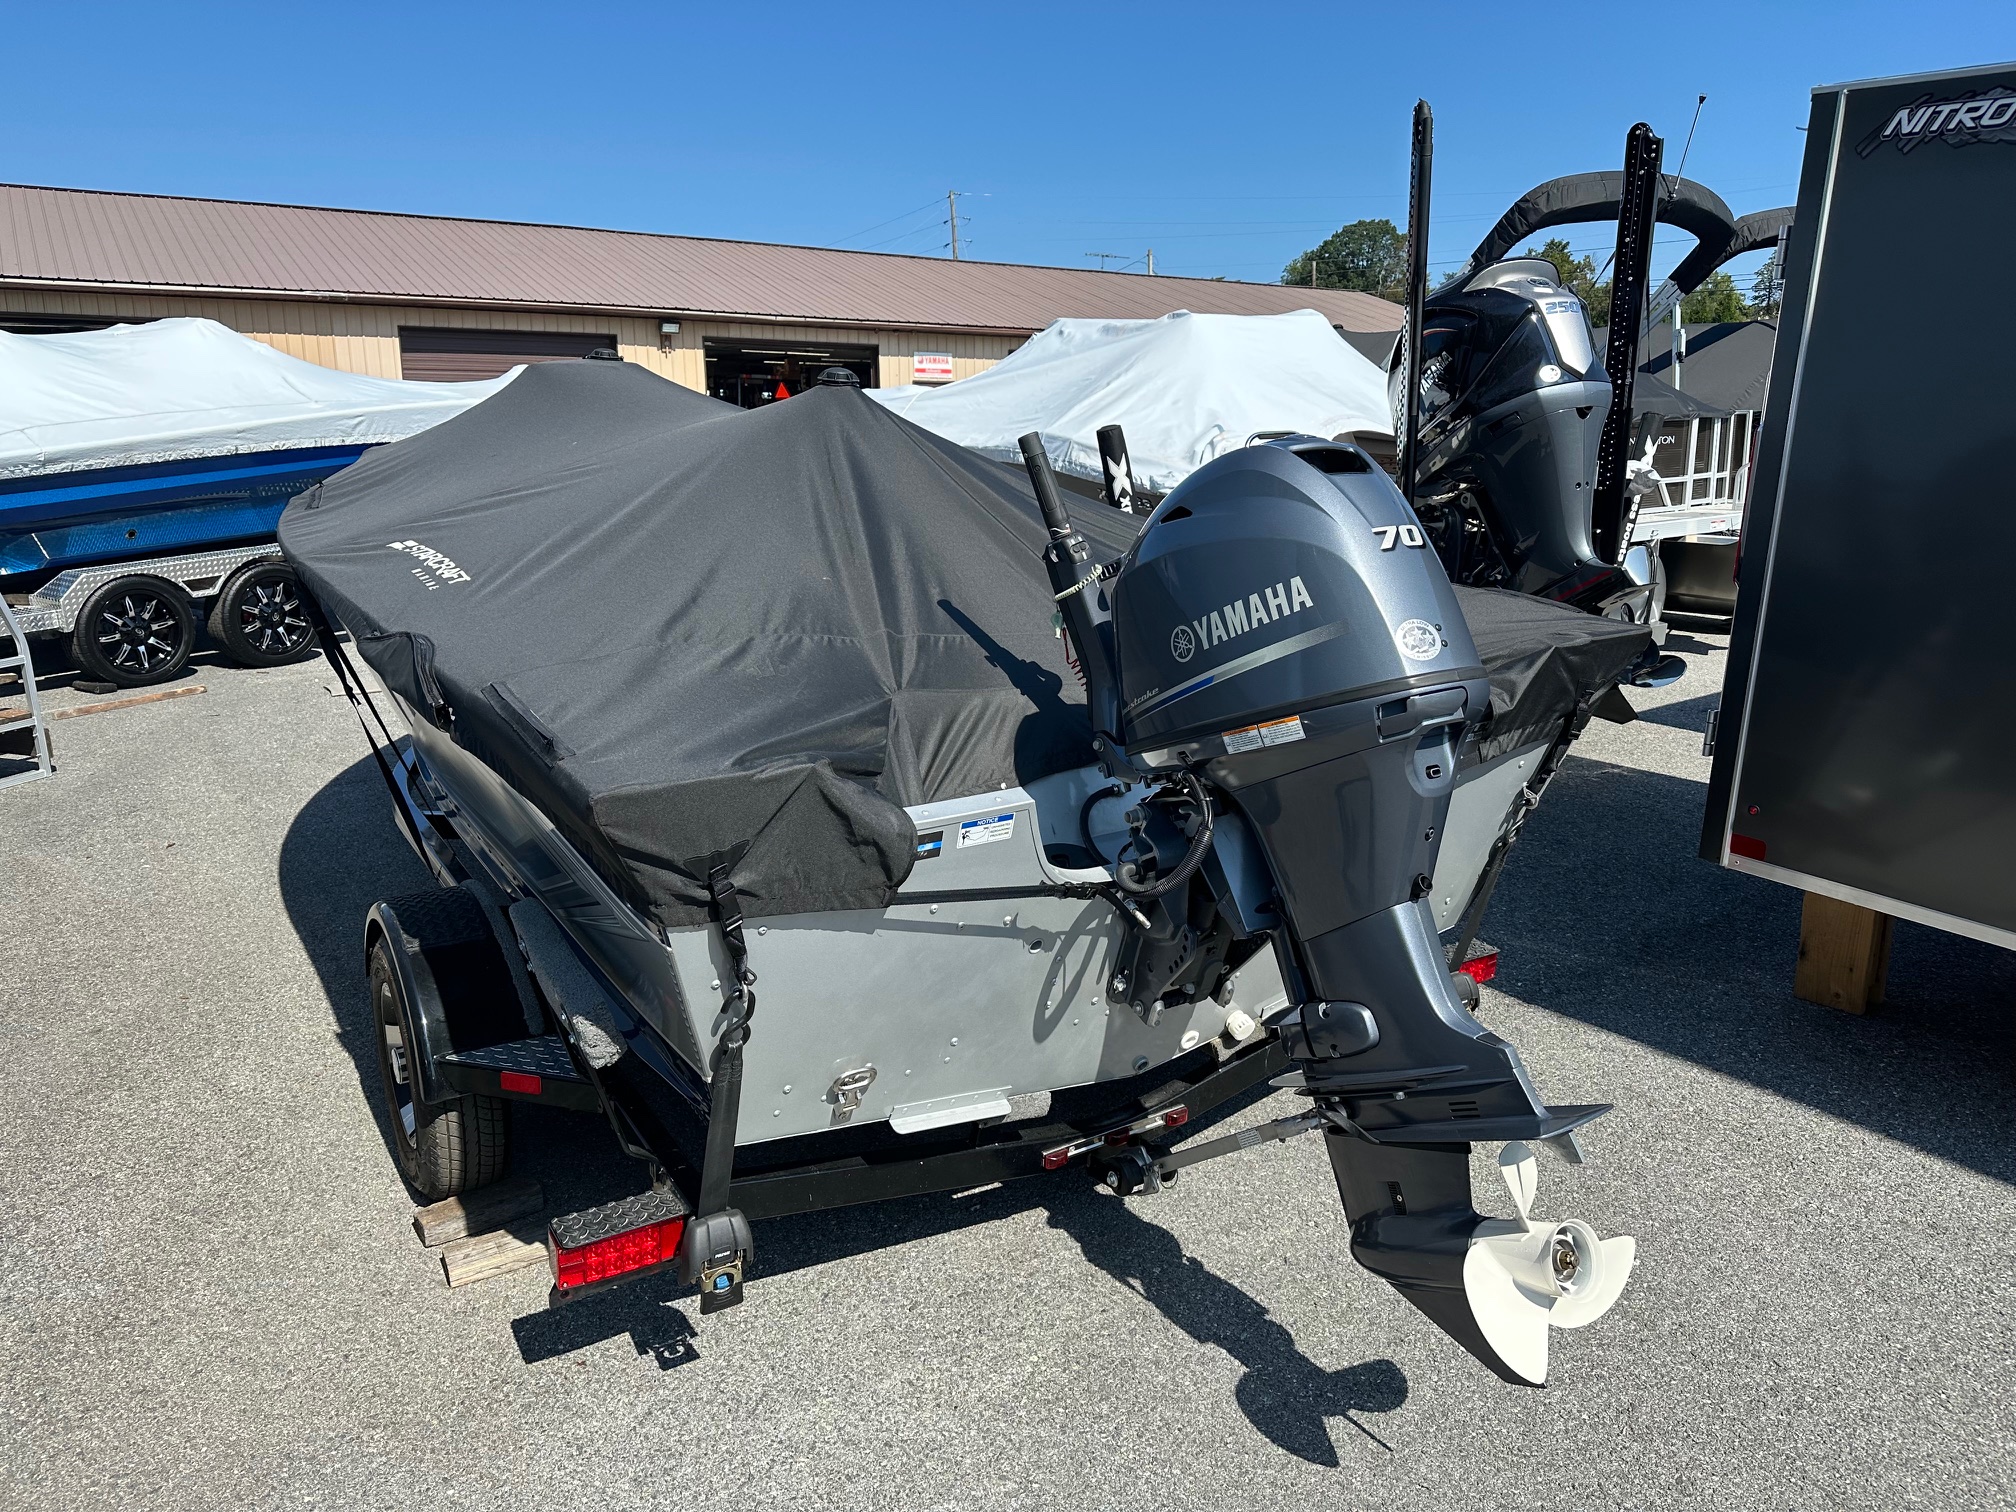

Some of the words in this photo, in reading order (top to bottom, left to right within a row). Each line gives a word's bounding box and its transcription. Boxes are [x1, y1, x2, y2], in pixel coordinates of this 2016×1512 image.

[1882, 98, 2016, 137] NITRO
[1545, 301, 1580, 314] 250
[1371, 524, 1424, 550] 70
[1617, 522, 1635, 562] boats
[404, 545, 471, 585] STARCRAFT
[1192, 575, 1314, 651] YAMAHA
[976, 817, 999, 826] NOTICE
